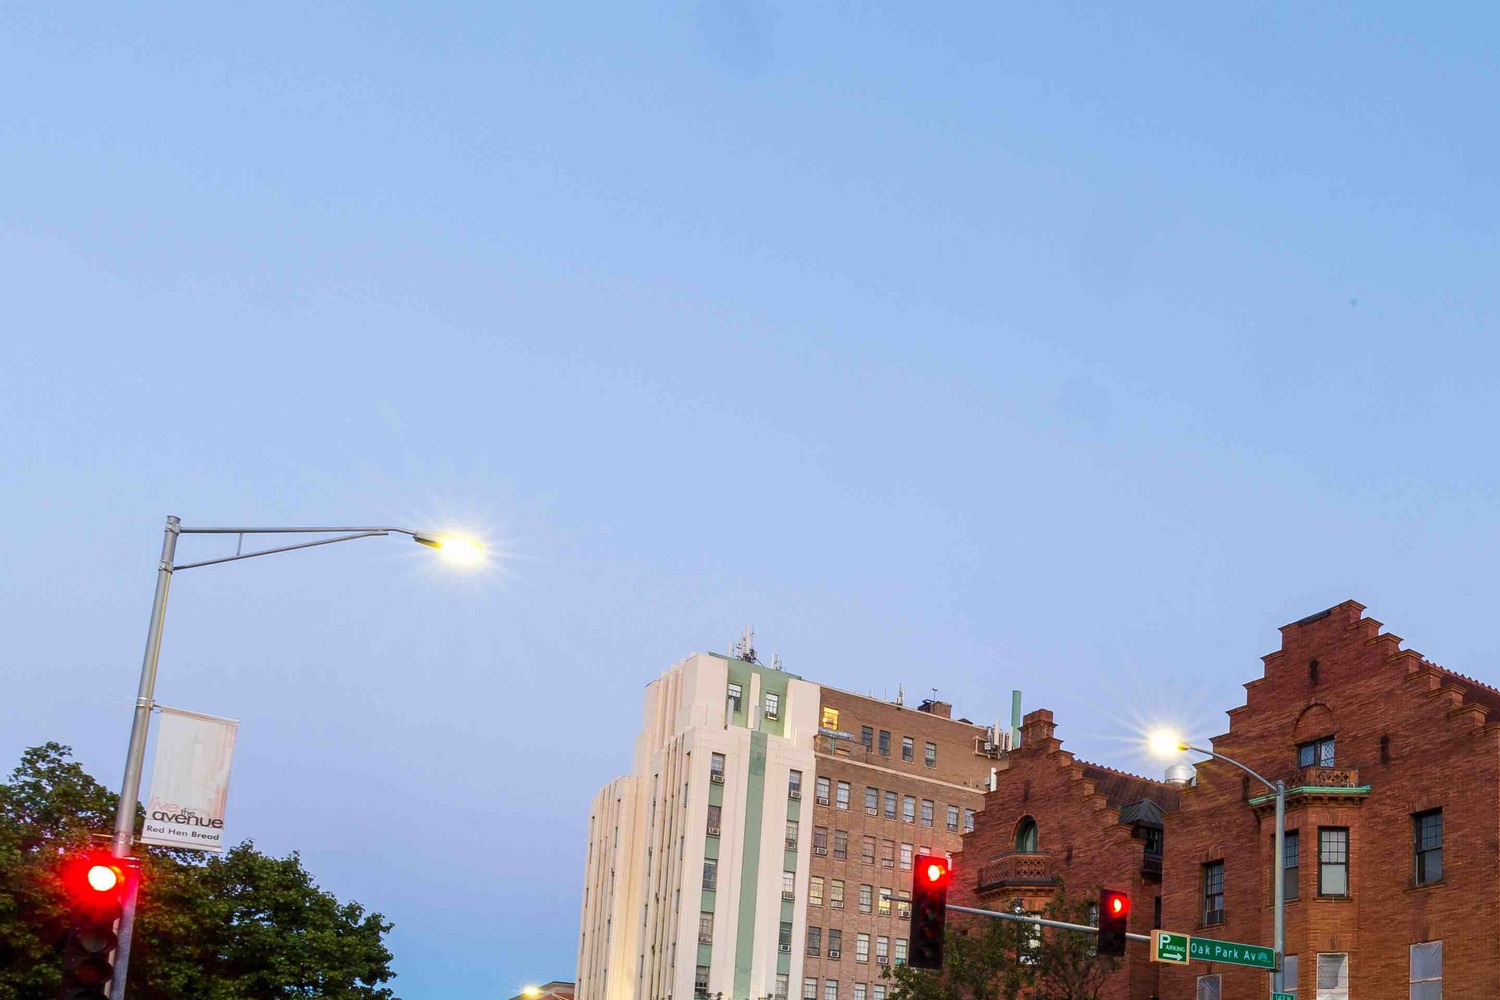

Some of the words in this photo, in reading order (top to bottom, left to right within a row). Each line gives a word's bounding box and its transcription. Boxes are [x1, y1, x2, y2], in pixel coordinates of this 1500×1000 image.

[152, 810, 224, 829] avenue
[181, 807, 196, 817] the
[146, 825, 165, 834] Red
[168, 828, 188, 837] Hen
[191, 831, 220, 841] Bread
[1159, 933, 1186, 953] PARKING
[1190, 942, 1211, 956] Oak
[1215, 946, 1239, 960] Park
[1243, 950, 1256, 961] Av
